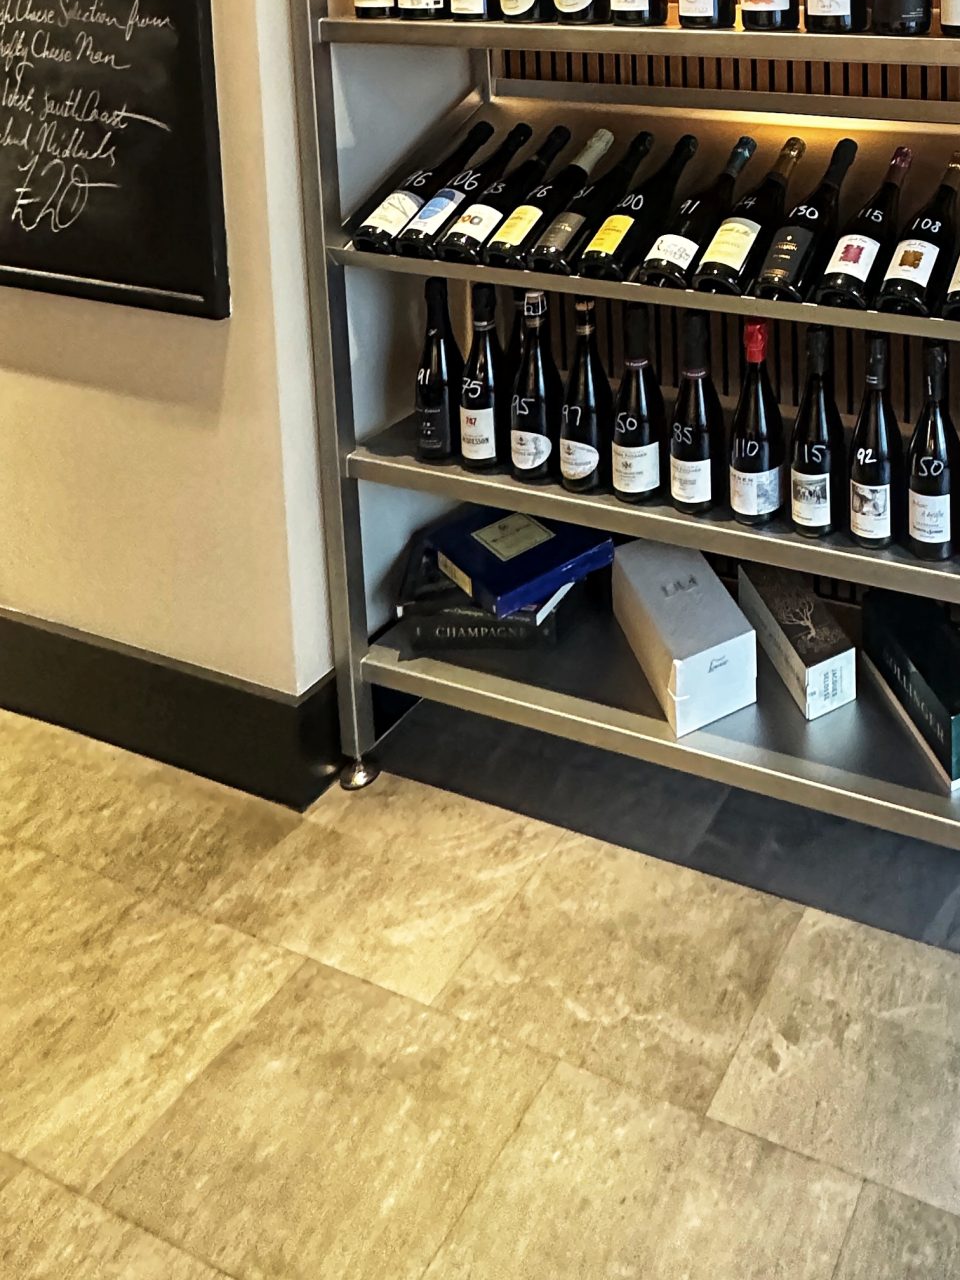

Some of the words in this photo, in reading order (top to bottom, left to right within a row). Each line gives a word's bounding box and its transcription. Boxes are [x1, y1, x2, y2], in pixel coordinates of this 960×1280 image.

[75, 31, 131, 69] Man
[912, 218, 942, 233] 108
[857, 448, 877, 465] 92
[436, 626, 526, 638] CHAMPAGNE
